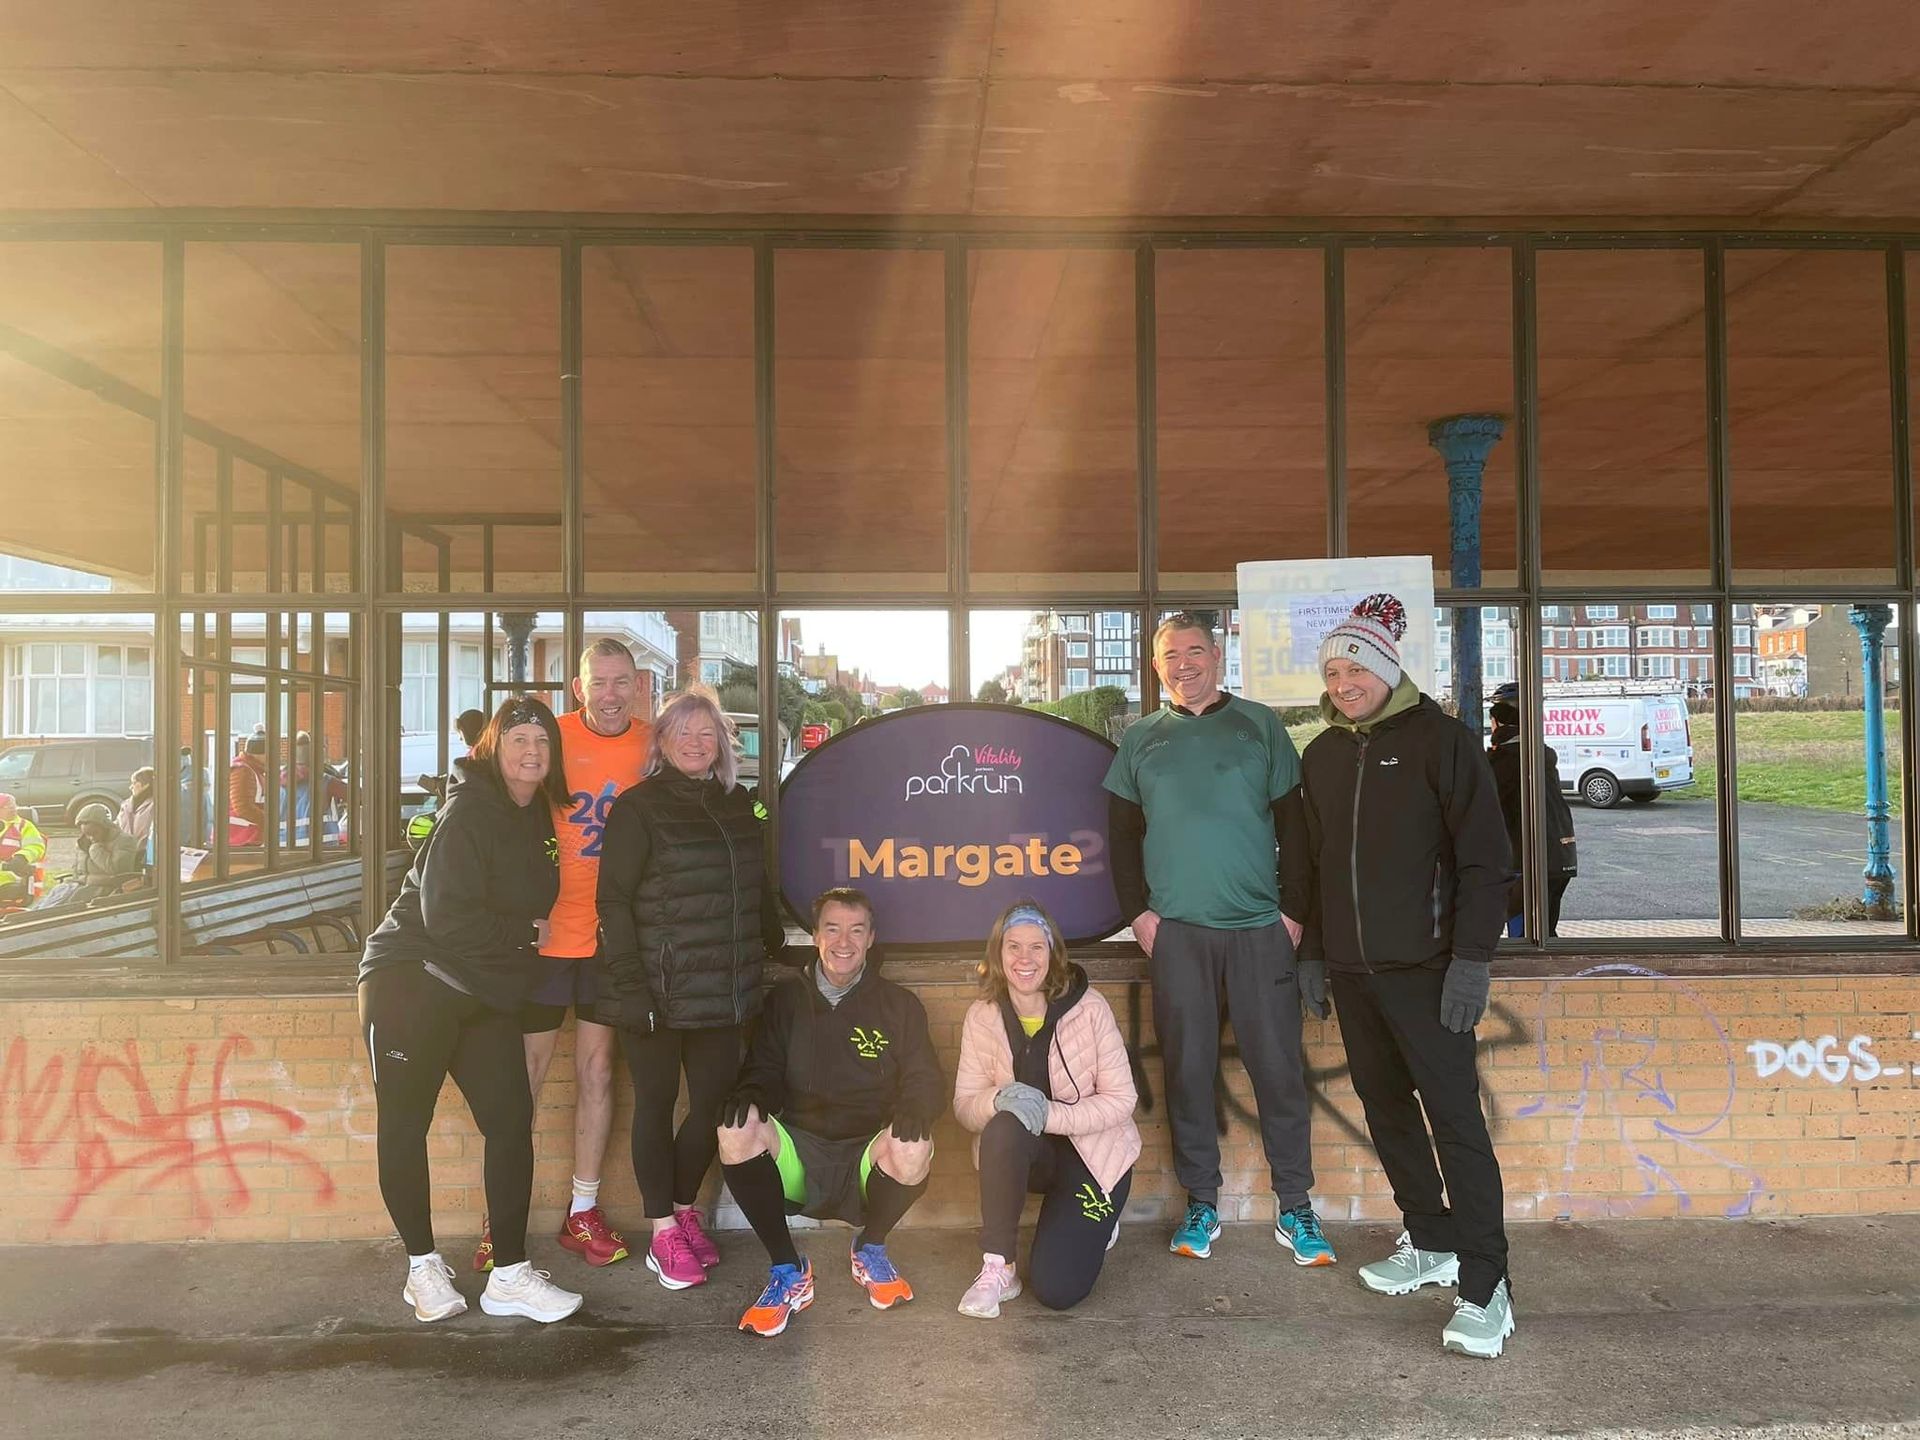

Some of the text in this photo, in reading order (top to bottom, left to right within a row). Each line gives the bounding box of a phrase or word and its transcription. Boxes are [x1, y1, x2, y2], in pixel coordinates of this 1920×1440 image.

[1298, 607, 1321, 616] FIRST
[1306, 619, 1327, 629] NEW
[1544, 723, 1606, 736] ERIALS
[974, 744, 1023, 770] Vitality
[905, 745, 1023, 801] parkrun
[849, 838, 1082, 887] Margate
